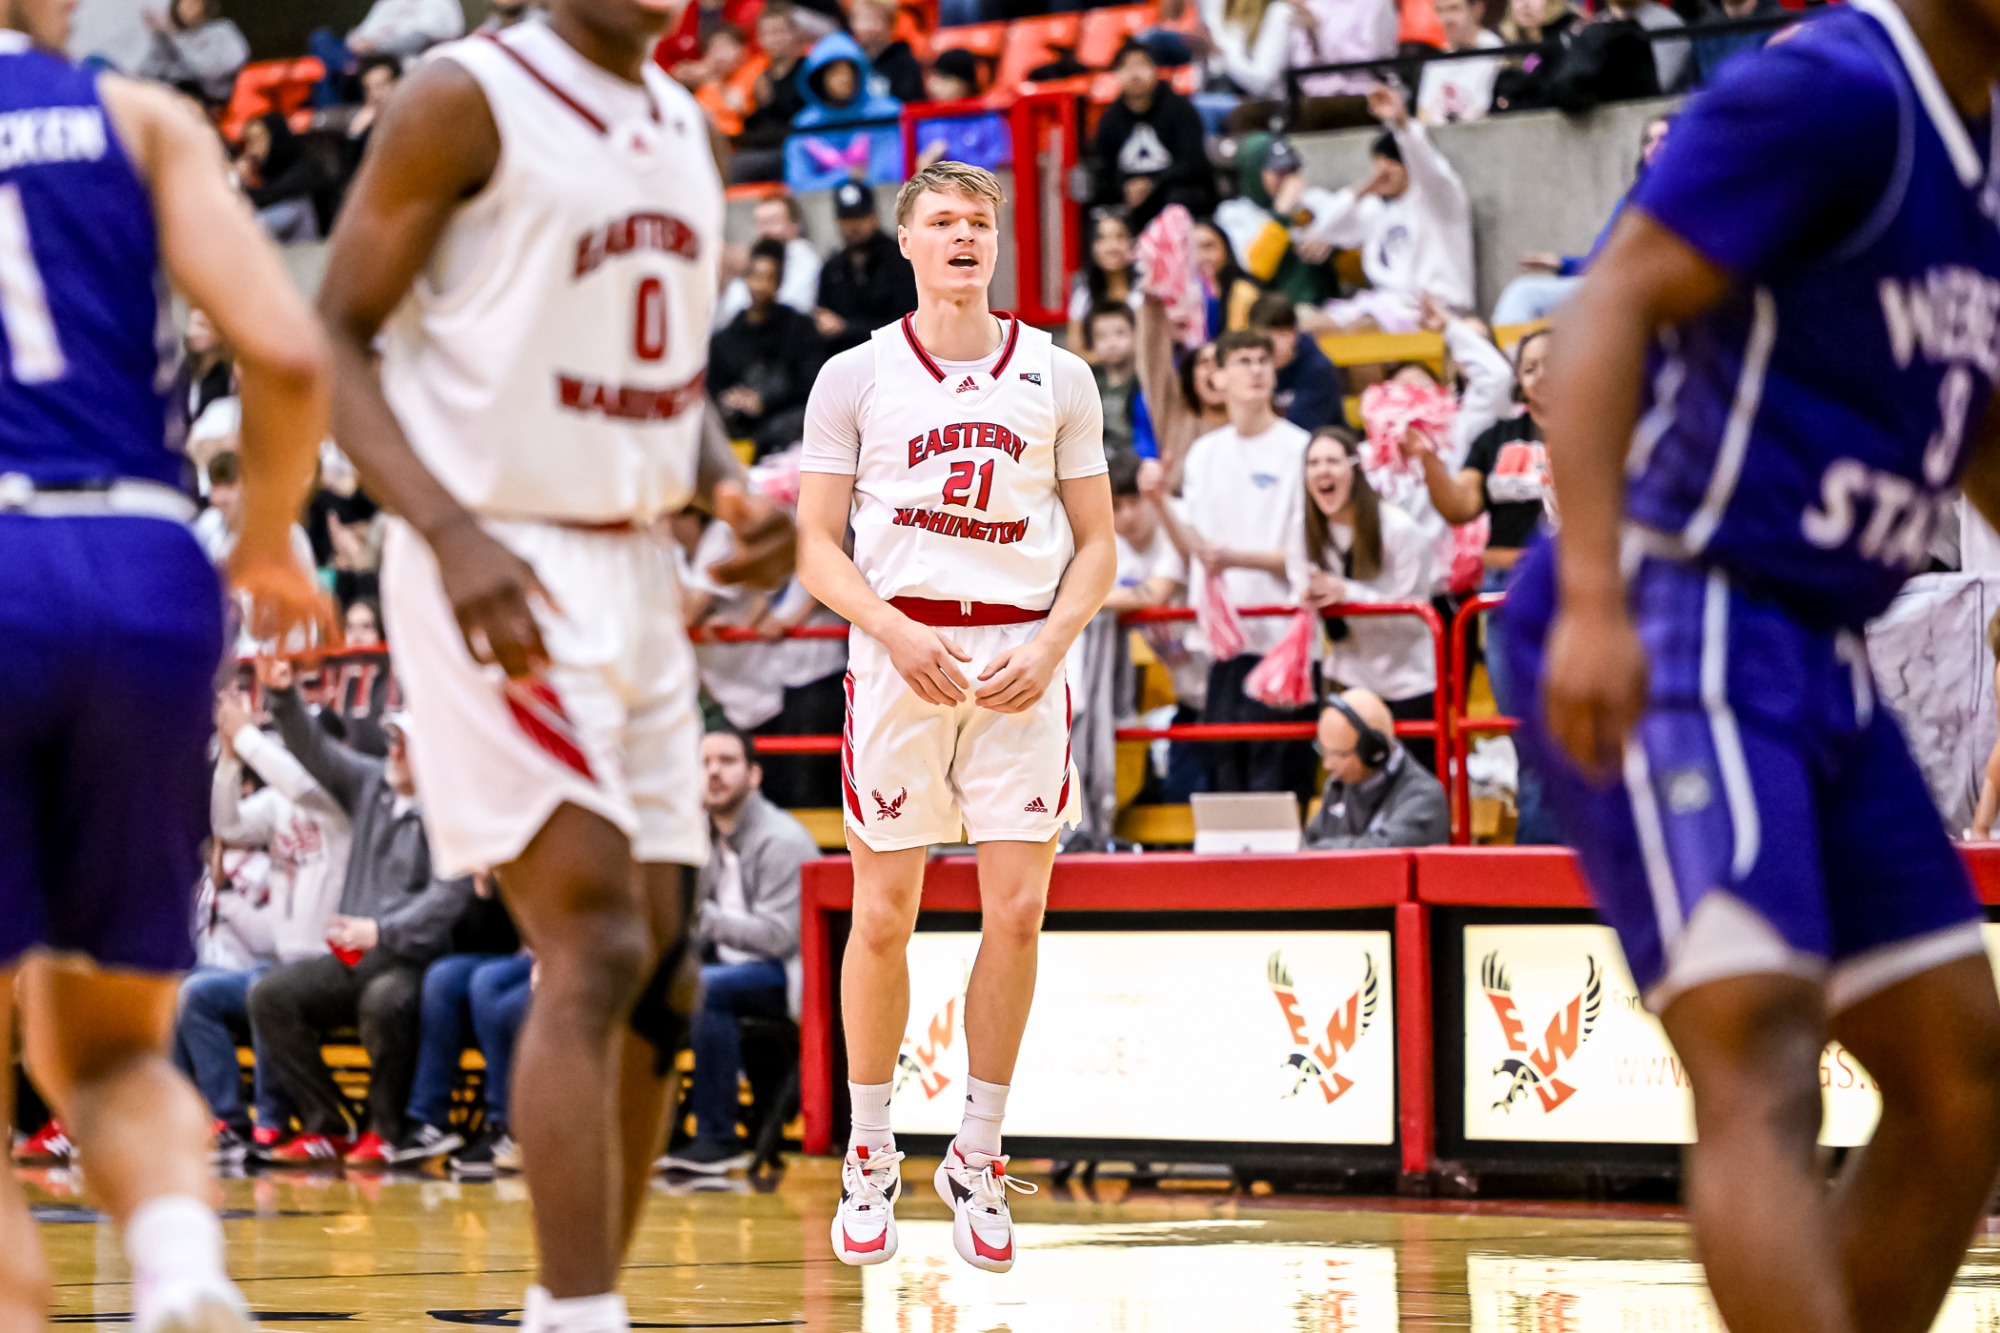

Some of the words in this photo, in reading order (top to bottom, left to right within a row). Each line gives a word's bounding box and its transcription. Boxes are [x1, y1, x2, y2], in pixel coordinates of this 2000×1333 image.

[635, 276, 668, 362] 0
[908, 422, 1028, 468] EASTERN
[942, 458, 995, 512] 21
[1024, 803, 1049, 813] adidas
